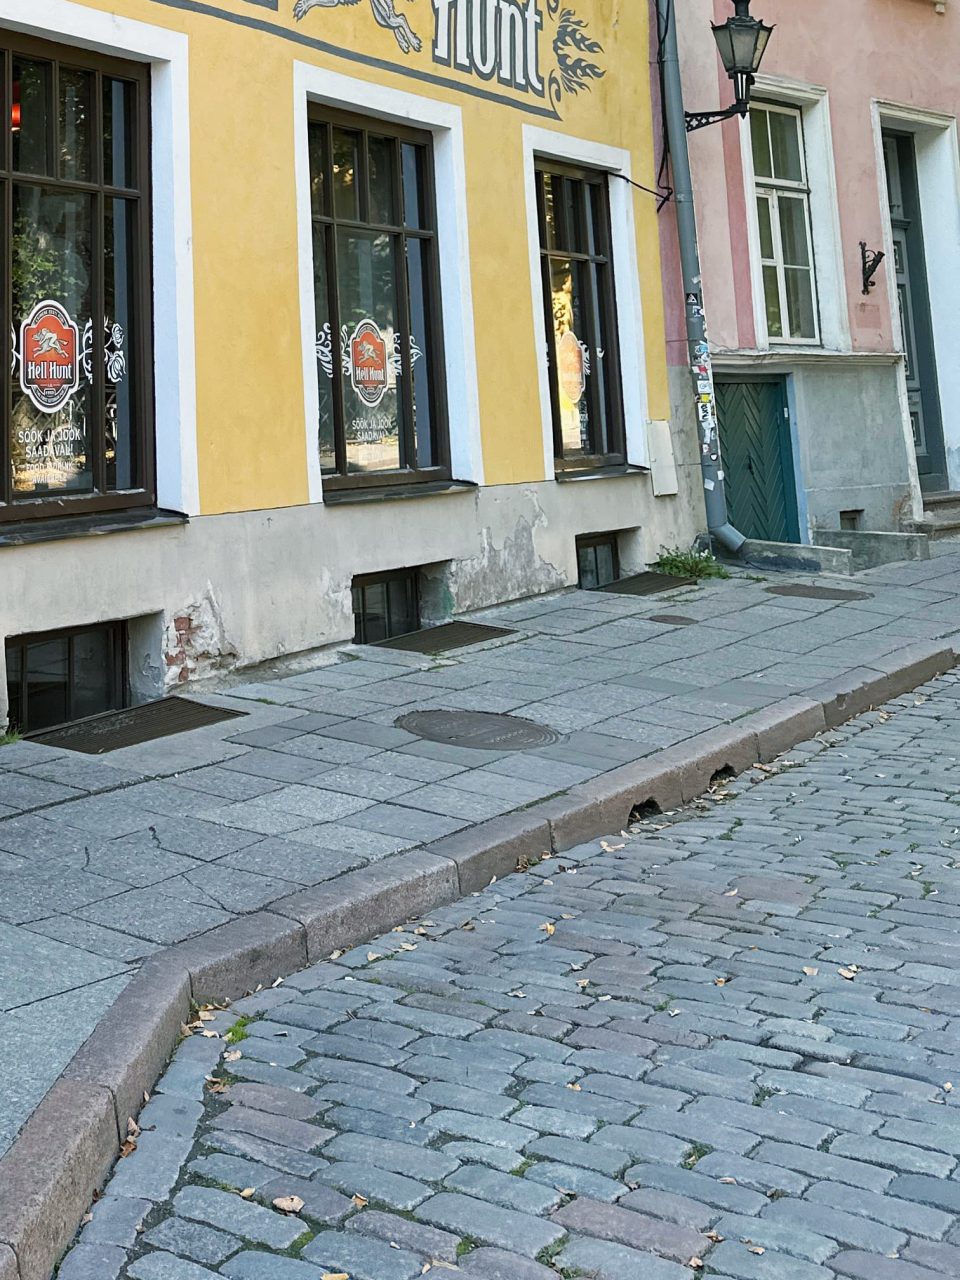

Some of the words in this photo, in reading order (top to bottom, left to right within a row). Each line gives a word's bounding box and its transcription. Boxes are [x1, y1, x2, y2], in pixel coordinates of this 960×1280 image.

[28, 361, 48, 380] Hell
[49, 361, 73, 380] Hunt
[356, 366, 369, 380] Hell
[369, 366, 385, 381] Hunt
[45, 429, 56, 442] JA
